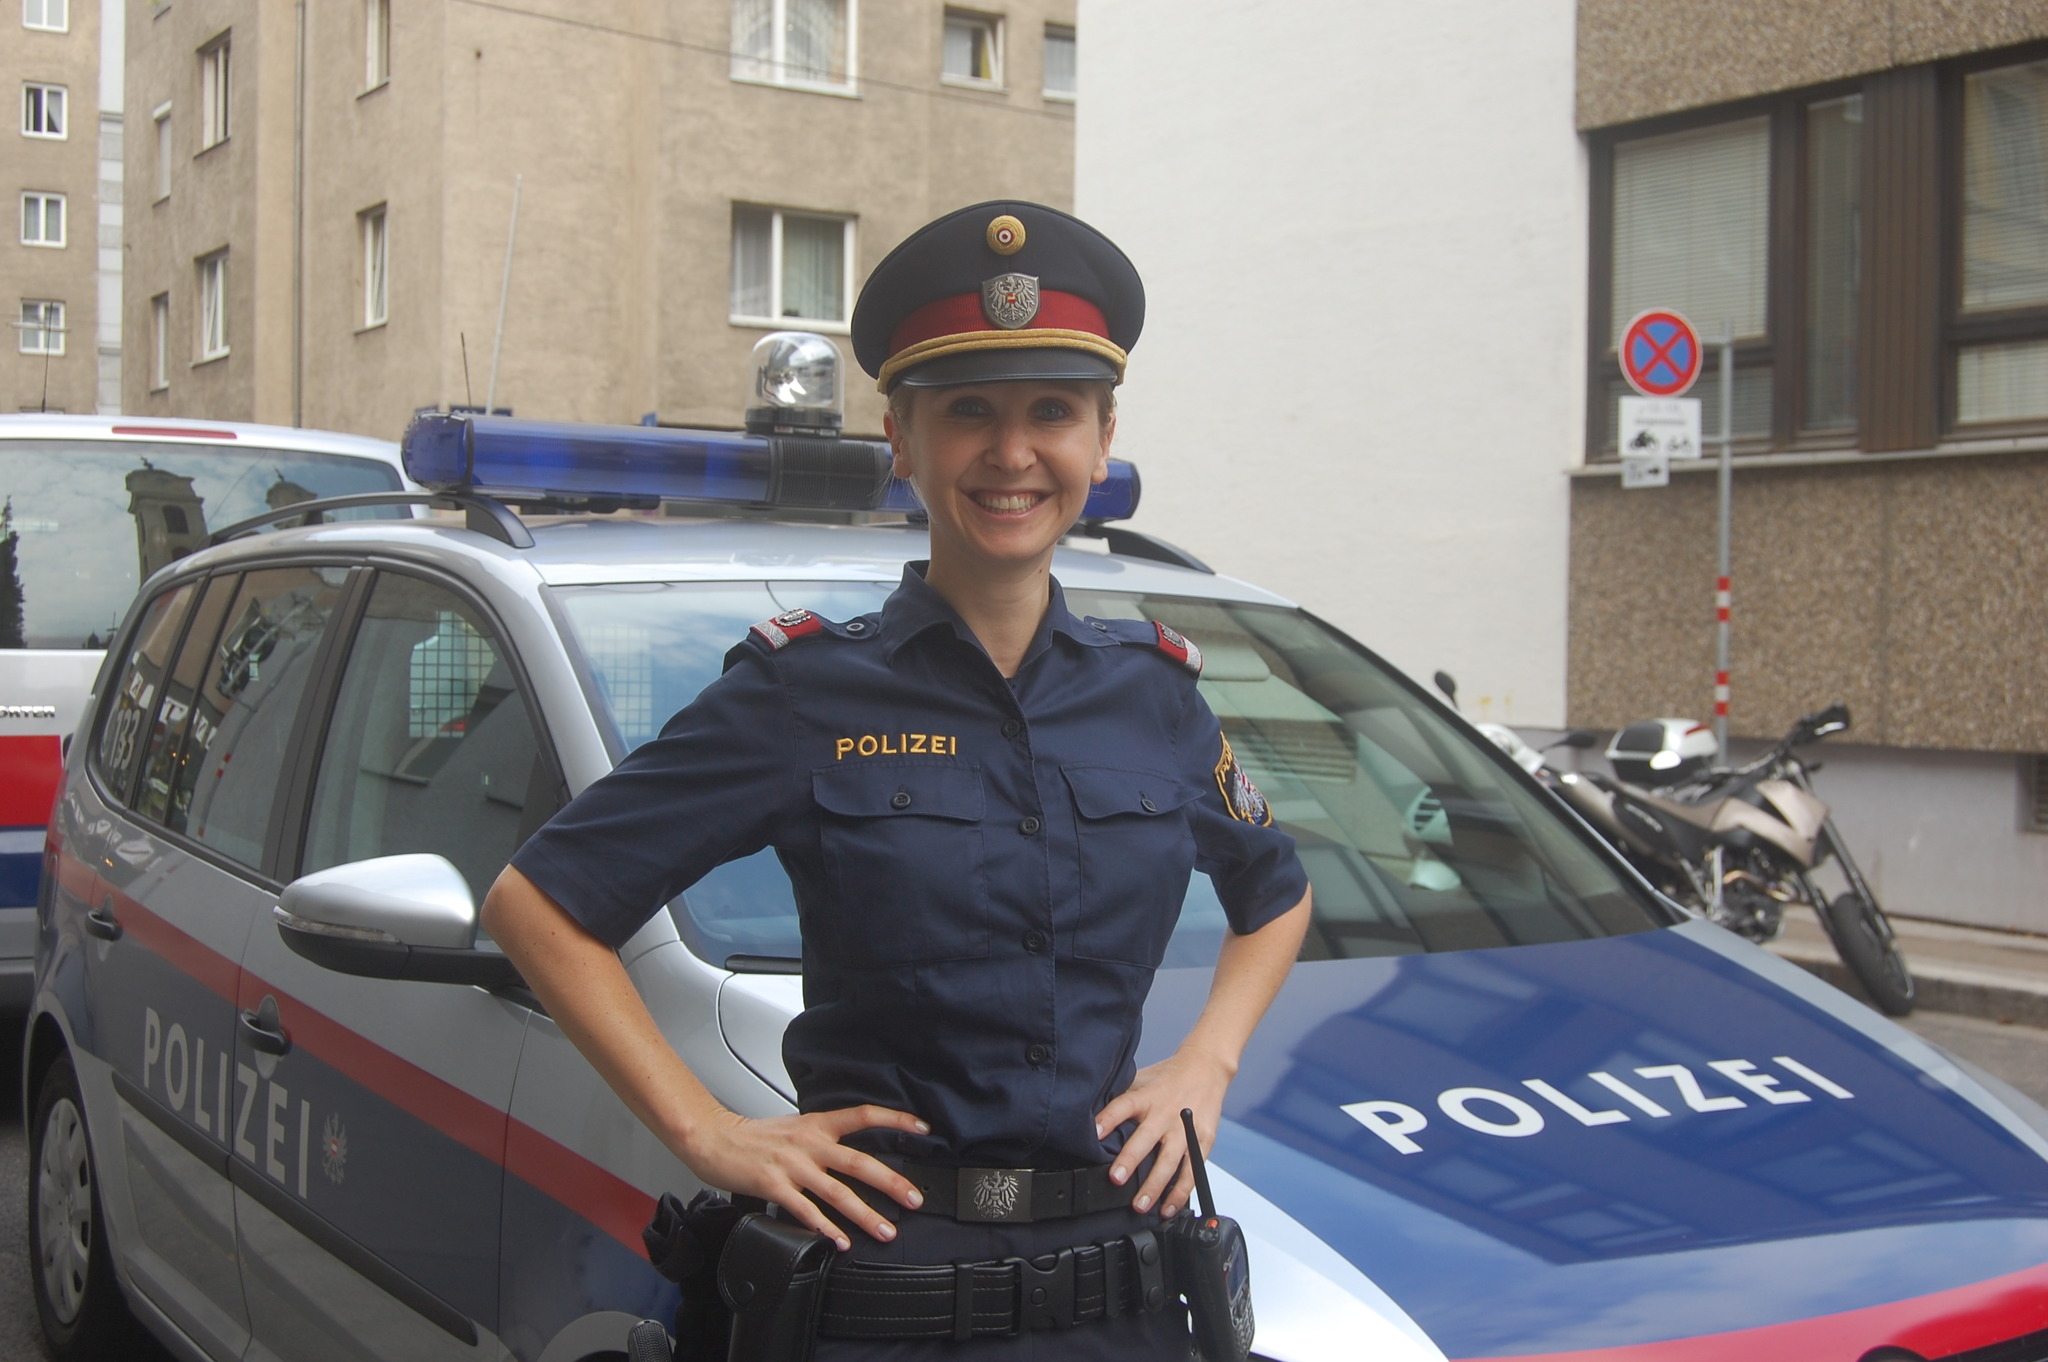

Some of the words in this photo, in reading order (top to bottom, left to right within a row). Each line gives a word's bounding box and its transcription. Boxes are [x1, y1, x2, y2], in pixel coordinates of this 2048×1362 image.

[835, 733, 957, 761] POLIZEI
[143, 1006, 310, 1199] POLIZEI
[1339, 1056, 1856, 1155] POLIZEI
